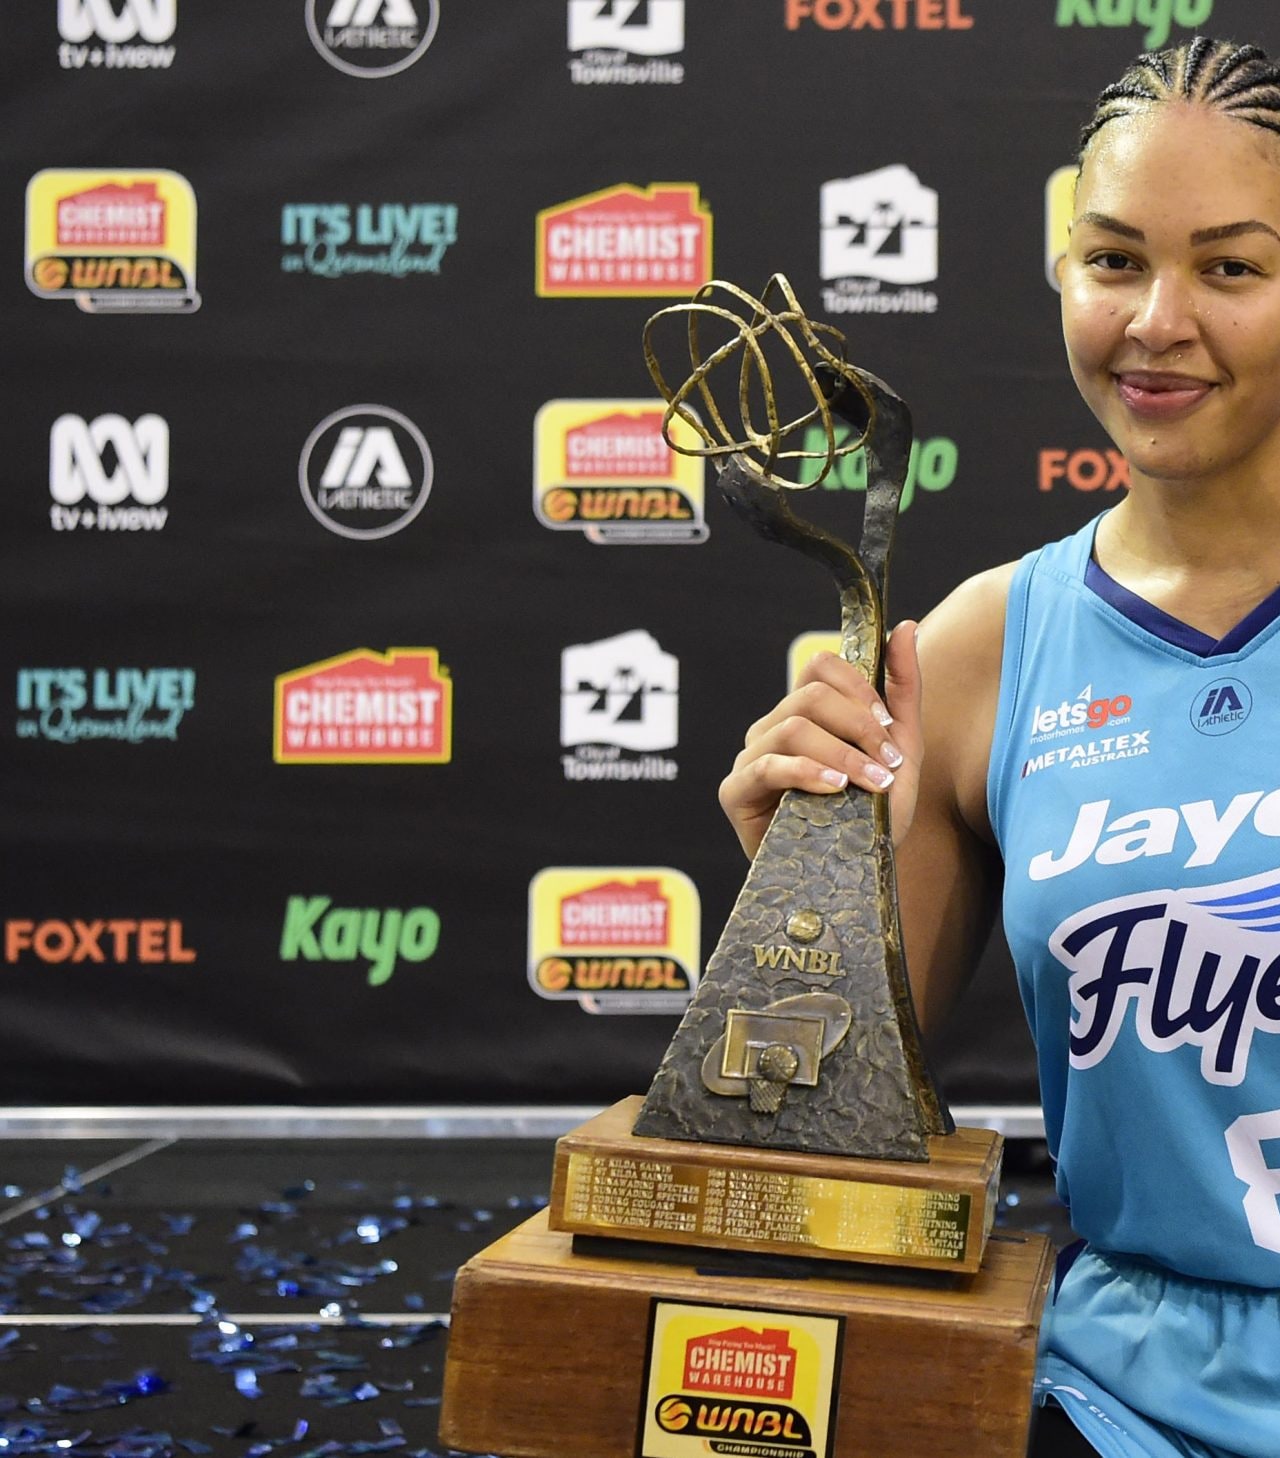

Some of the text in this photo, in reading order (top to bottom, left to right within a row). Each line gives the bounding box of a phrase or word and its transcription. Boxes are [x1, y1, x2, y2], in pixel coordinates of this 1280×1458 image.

[784, 0, 973, 30] FOXTEL
[568, 59, 684, 84] Townsville
[59, 204, 162, 228] CHEMIST
[282, 204, 457, 245] IT'S LIVE!
[550, 224, 699, 258] CHEMIST
[821, 287, 937, 313] Townsville
[801, 427, 958, 513] Kao
[1038, 449, 1129, 491] FOX
[17, 668, 195, 710] IT'S LIVE!
[287, 688, 440, 724] CHEMIST
[562, 755, 677, 780] Townsville
[1025, 730, 1151, 778] METALTEX
[1071, 746, 1150, 769] AUSTRALIA
[562, 903, 666, 927] CHEMIST
[4, 920, 196, 963] FOXTEL
[280, 896, 440, 985] Kayo
[752, 944, 846, 976] WNBL
[690, 1346, 791, 1377] CHEMIST
[689, 1371, 785, 1391] WAREHOUSE
[696, 1404, 803, 1439] WNBL
[717, 1443, 804, 1458] CHAMPIONSHIP
